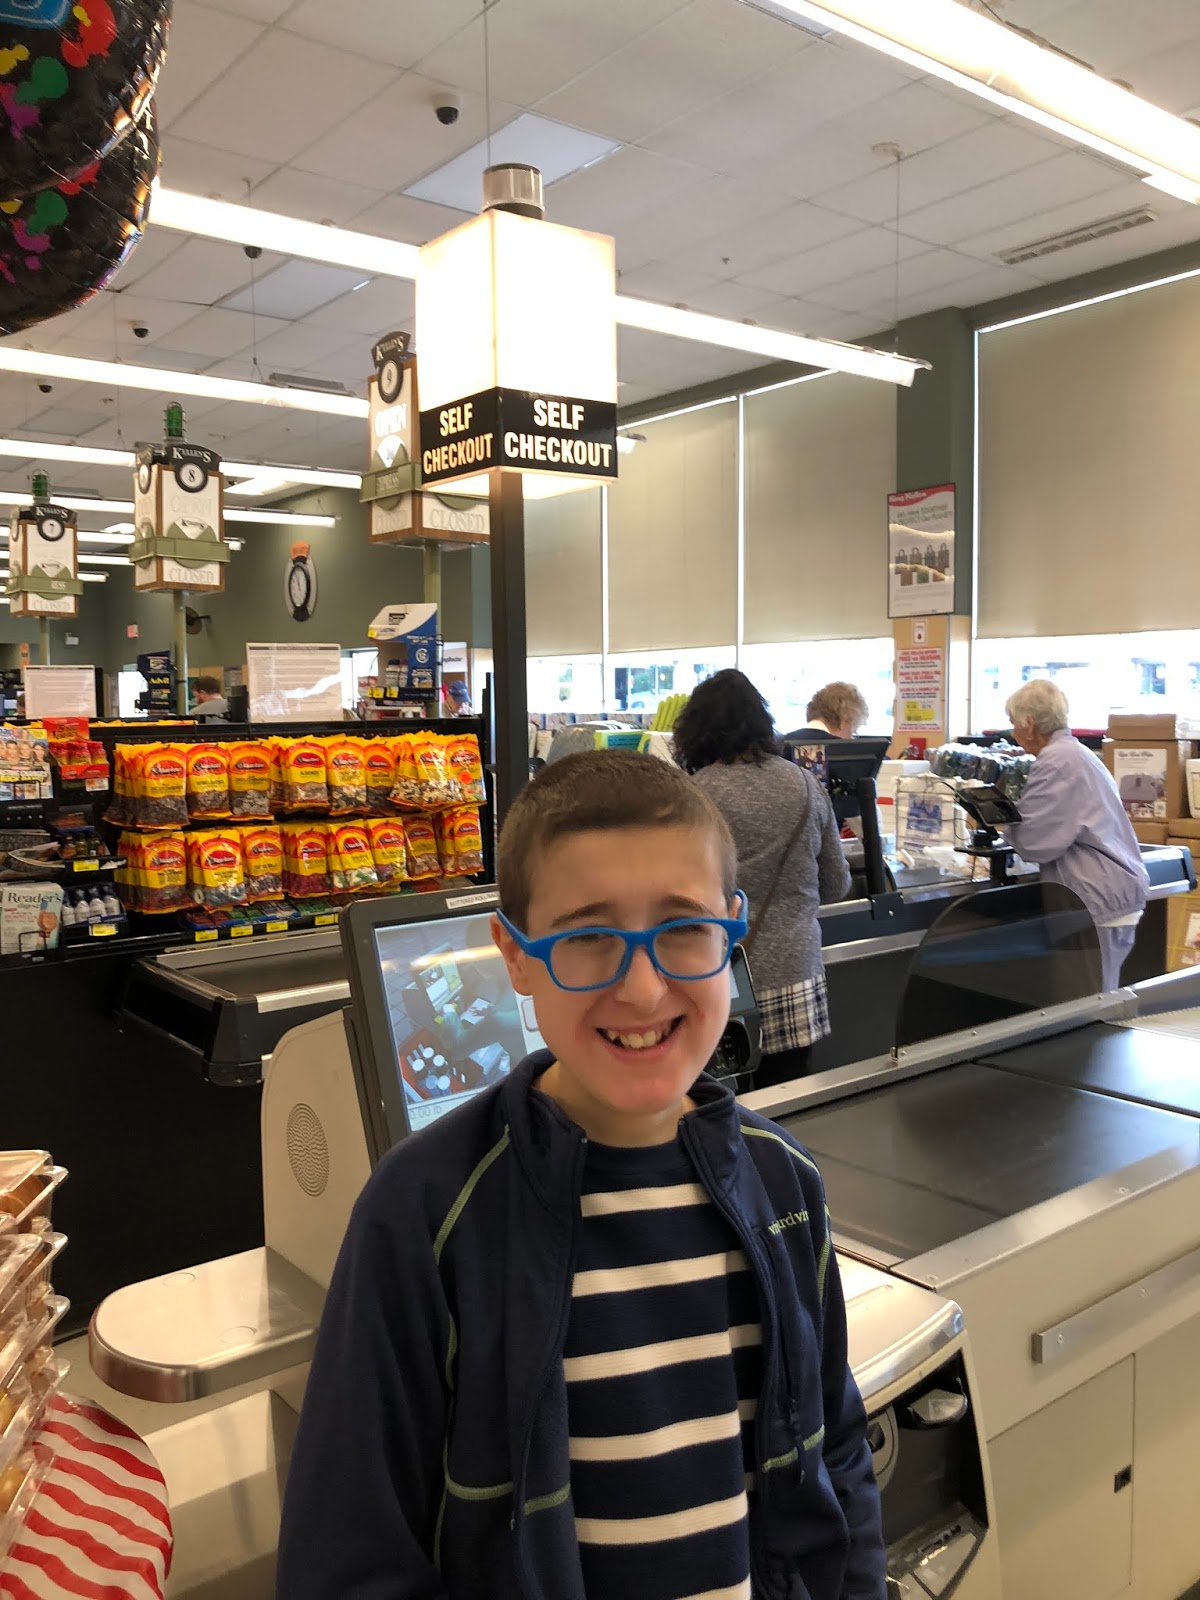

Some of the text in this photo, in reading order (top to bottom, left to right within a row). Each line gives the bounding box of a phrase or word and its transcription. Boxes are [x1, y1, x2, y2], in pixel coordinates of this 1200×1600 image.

[440, 402, 473, 437] SELF
[533, 399, 585, 431] SELF
[423, 432, 493, 475] CHECKOUT
[504, 431, 612, 468] CHECKOUT
[430, 508, 485, 532] CLOSED
[169, 567, 214, 584] CLOSED
[8, 892, 62, 903] Reader's
